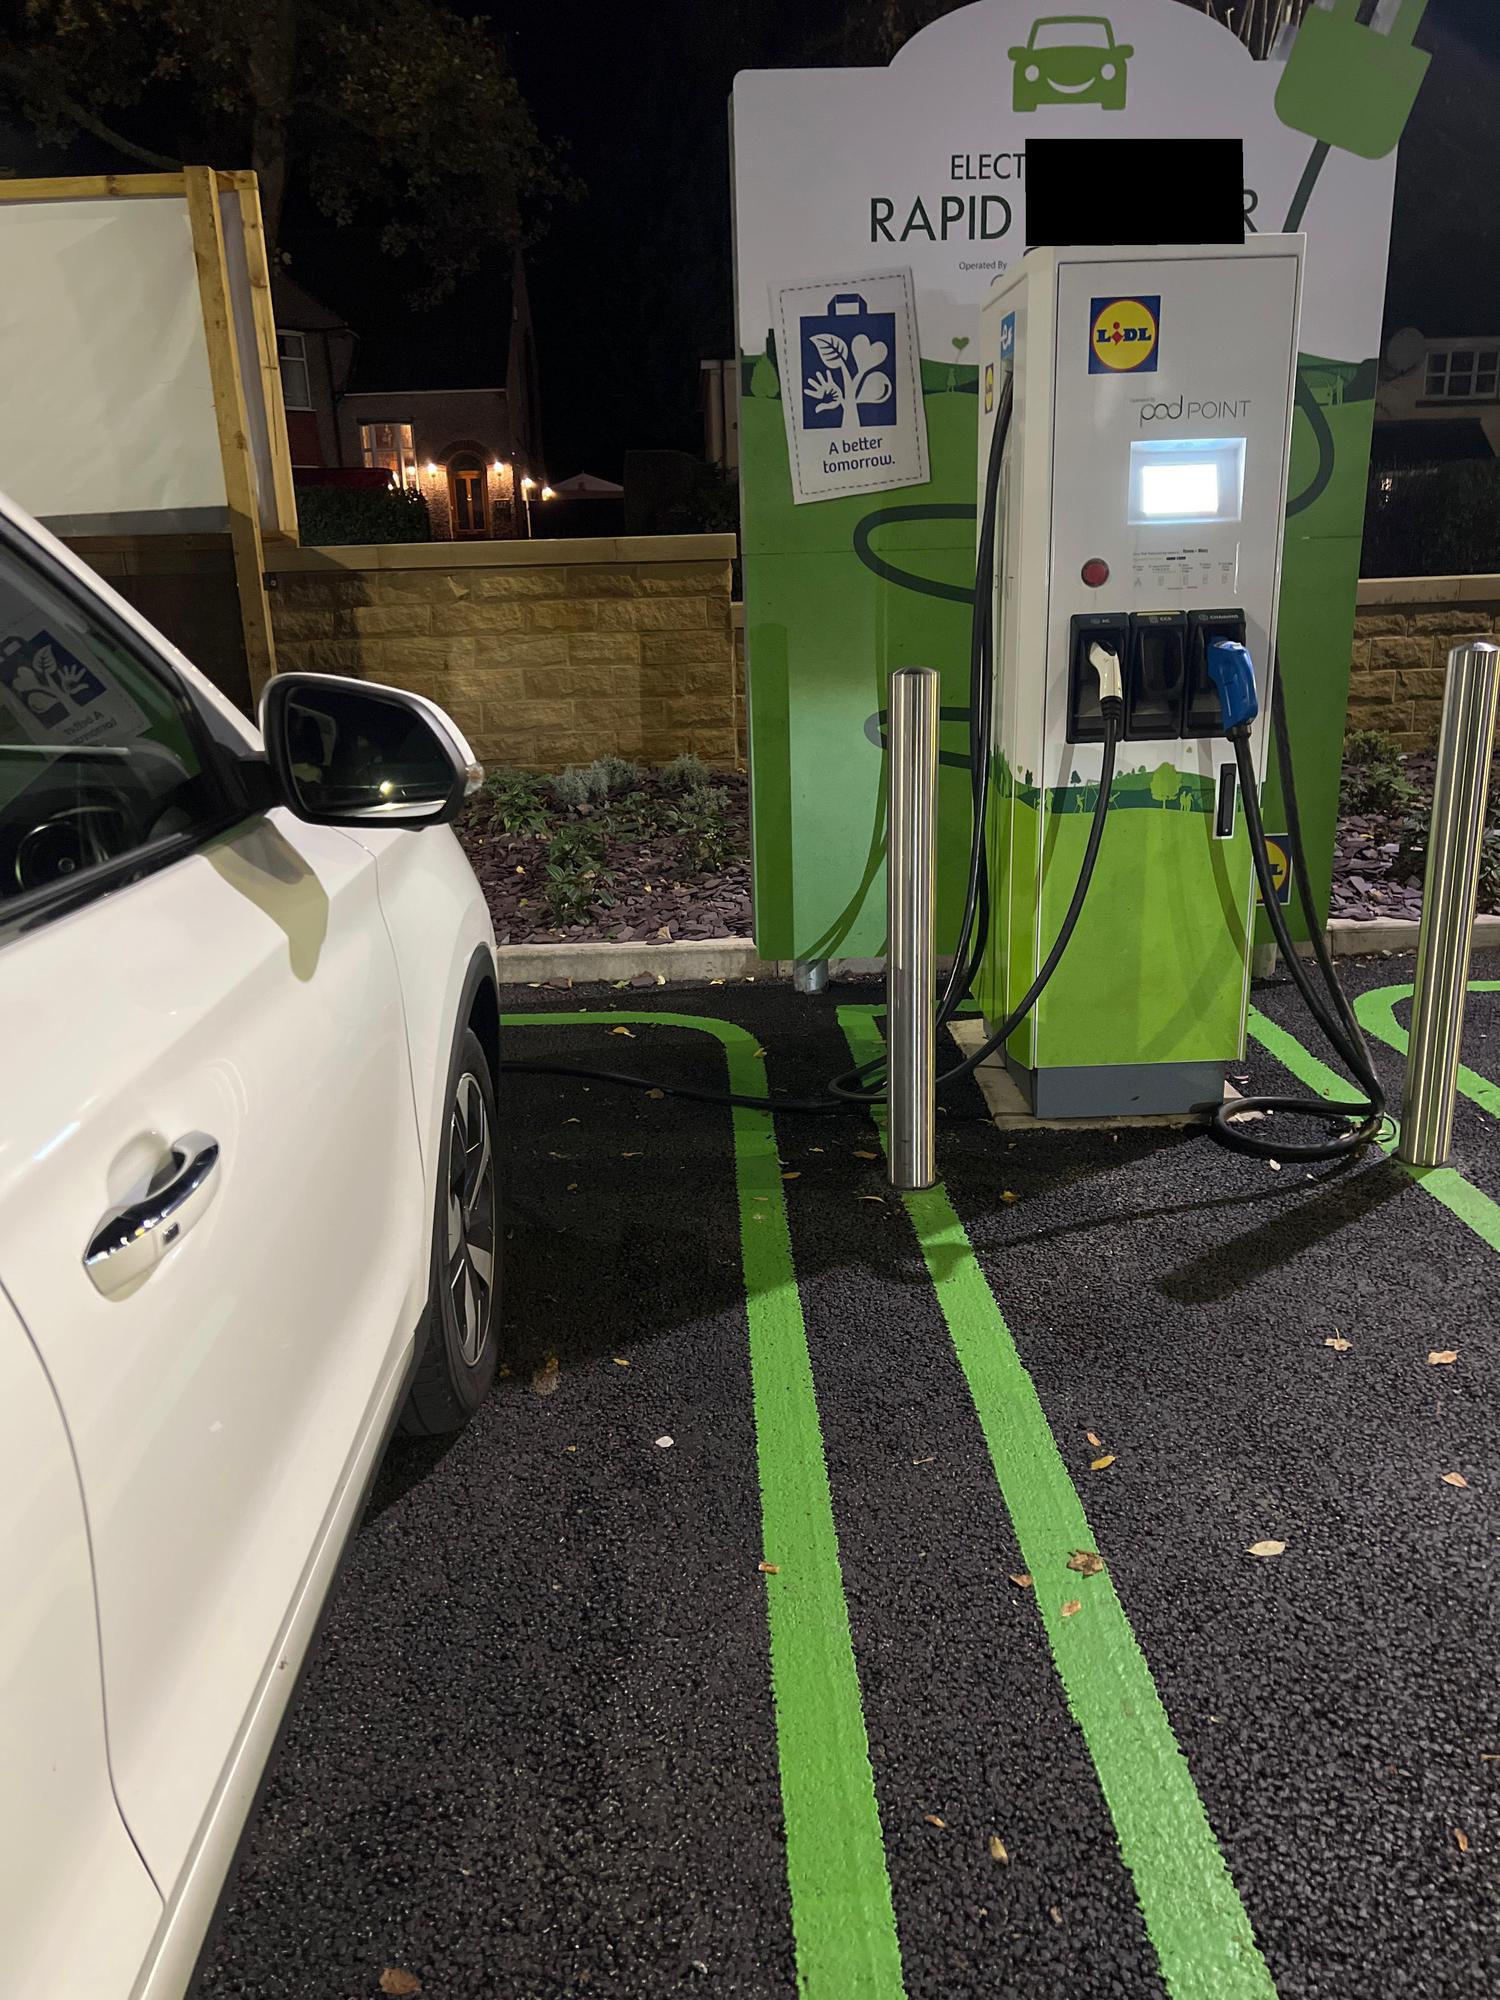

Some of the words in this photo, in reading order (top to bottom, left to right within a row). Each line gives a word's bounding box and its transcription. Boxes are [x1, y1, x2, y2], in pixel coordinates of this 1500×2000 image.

[951, 153, 1026, 180] ELECT
[871, 195, 1012, 242] RAPID
[959, 261, 996, 270] Operated
[997, 260, 1007, 270] By
[1140, 395, 1183, 428] pod
[1187, 400, 1251, 419] POINT
[829, 442, 839, 455] A
[843, 437, 883, 452] better
[823, 454, 895, 473] tomorrow.
